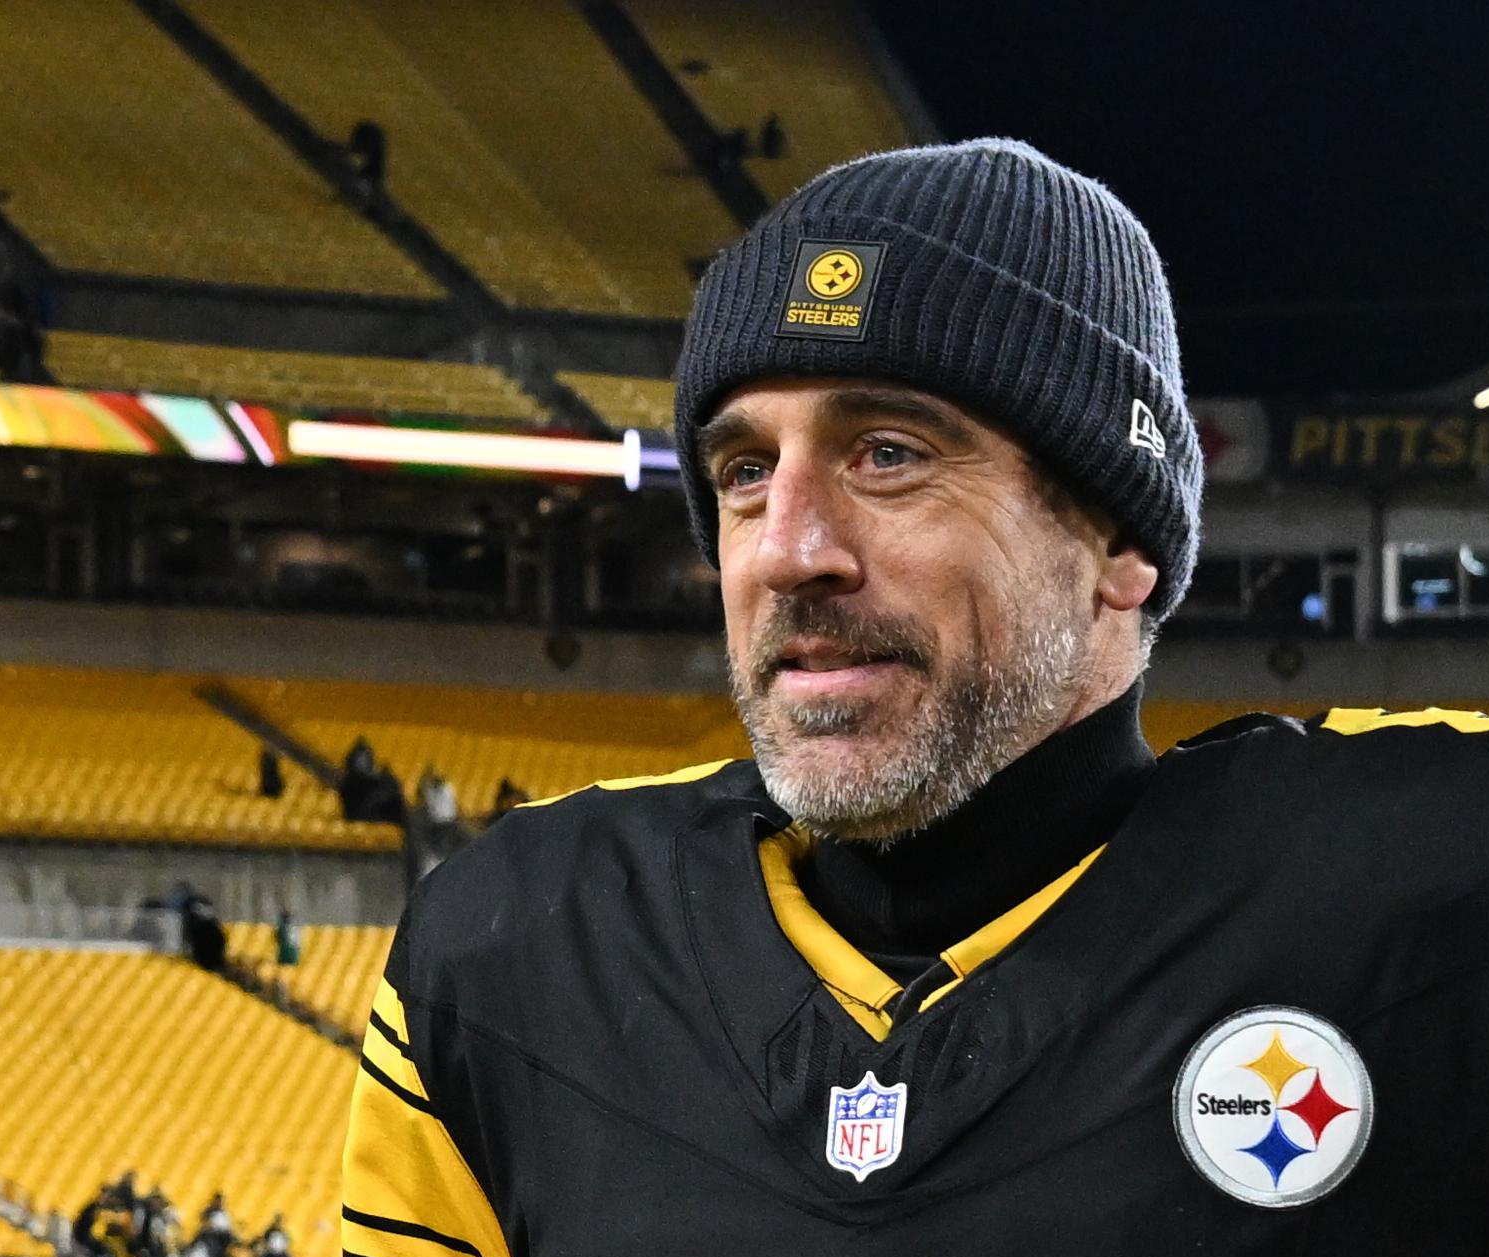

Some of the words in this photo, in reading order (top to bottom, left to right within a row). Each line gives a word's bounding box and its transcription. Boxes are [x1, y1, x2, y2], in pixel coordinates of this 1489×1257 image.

[787, 309, 860, 327] STEELERS
[1197, 1093, 1272, 1116] Steelers
[839, 1123, 888, 1160] NFL
